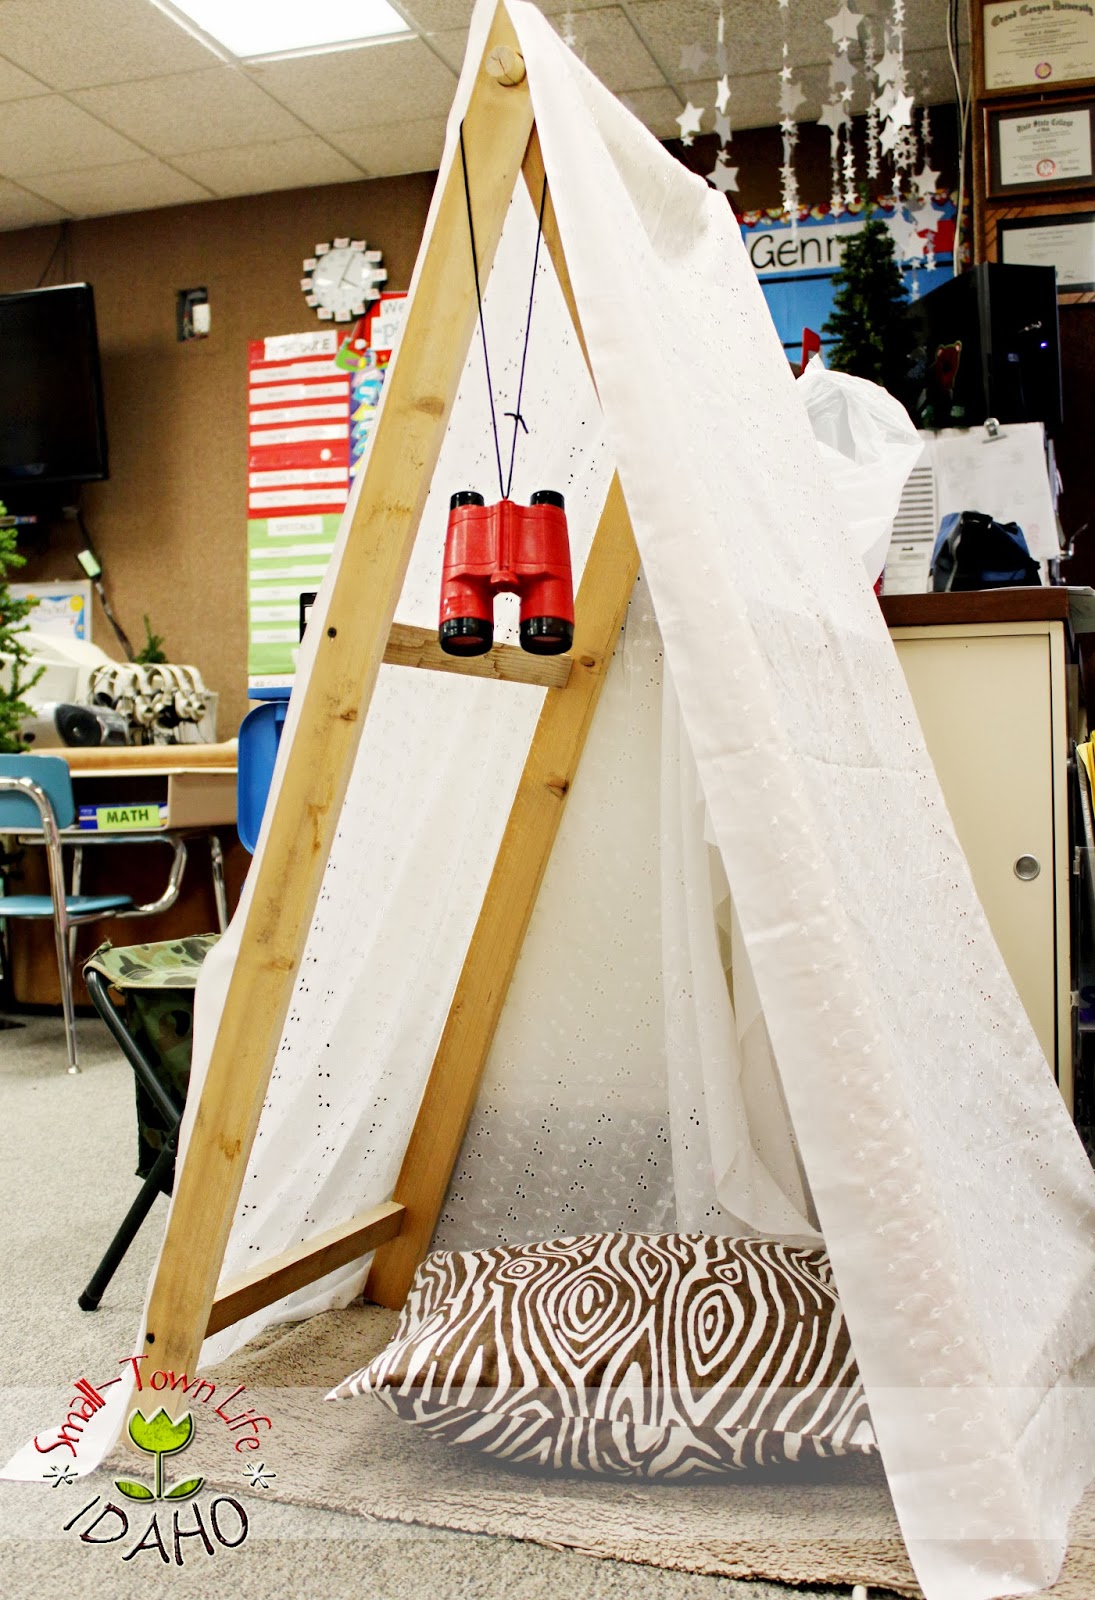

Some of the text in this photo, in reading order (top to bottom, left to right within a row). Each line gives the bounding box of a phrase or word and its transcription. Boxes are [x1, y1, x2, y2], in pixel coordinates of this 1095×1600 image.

[991, 10, 1017, 27] Grand
[1019, 4, 1051, 16] Canyon
[1053, 0, 1093, 16] University
[1033, 119, 1049, 127] State
[1051, 119, 1073, 127] College
[750, 234, 836, 269] Genr
[106, 809, 149, 823] MATH
